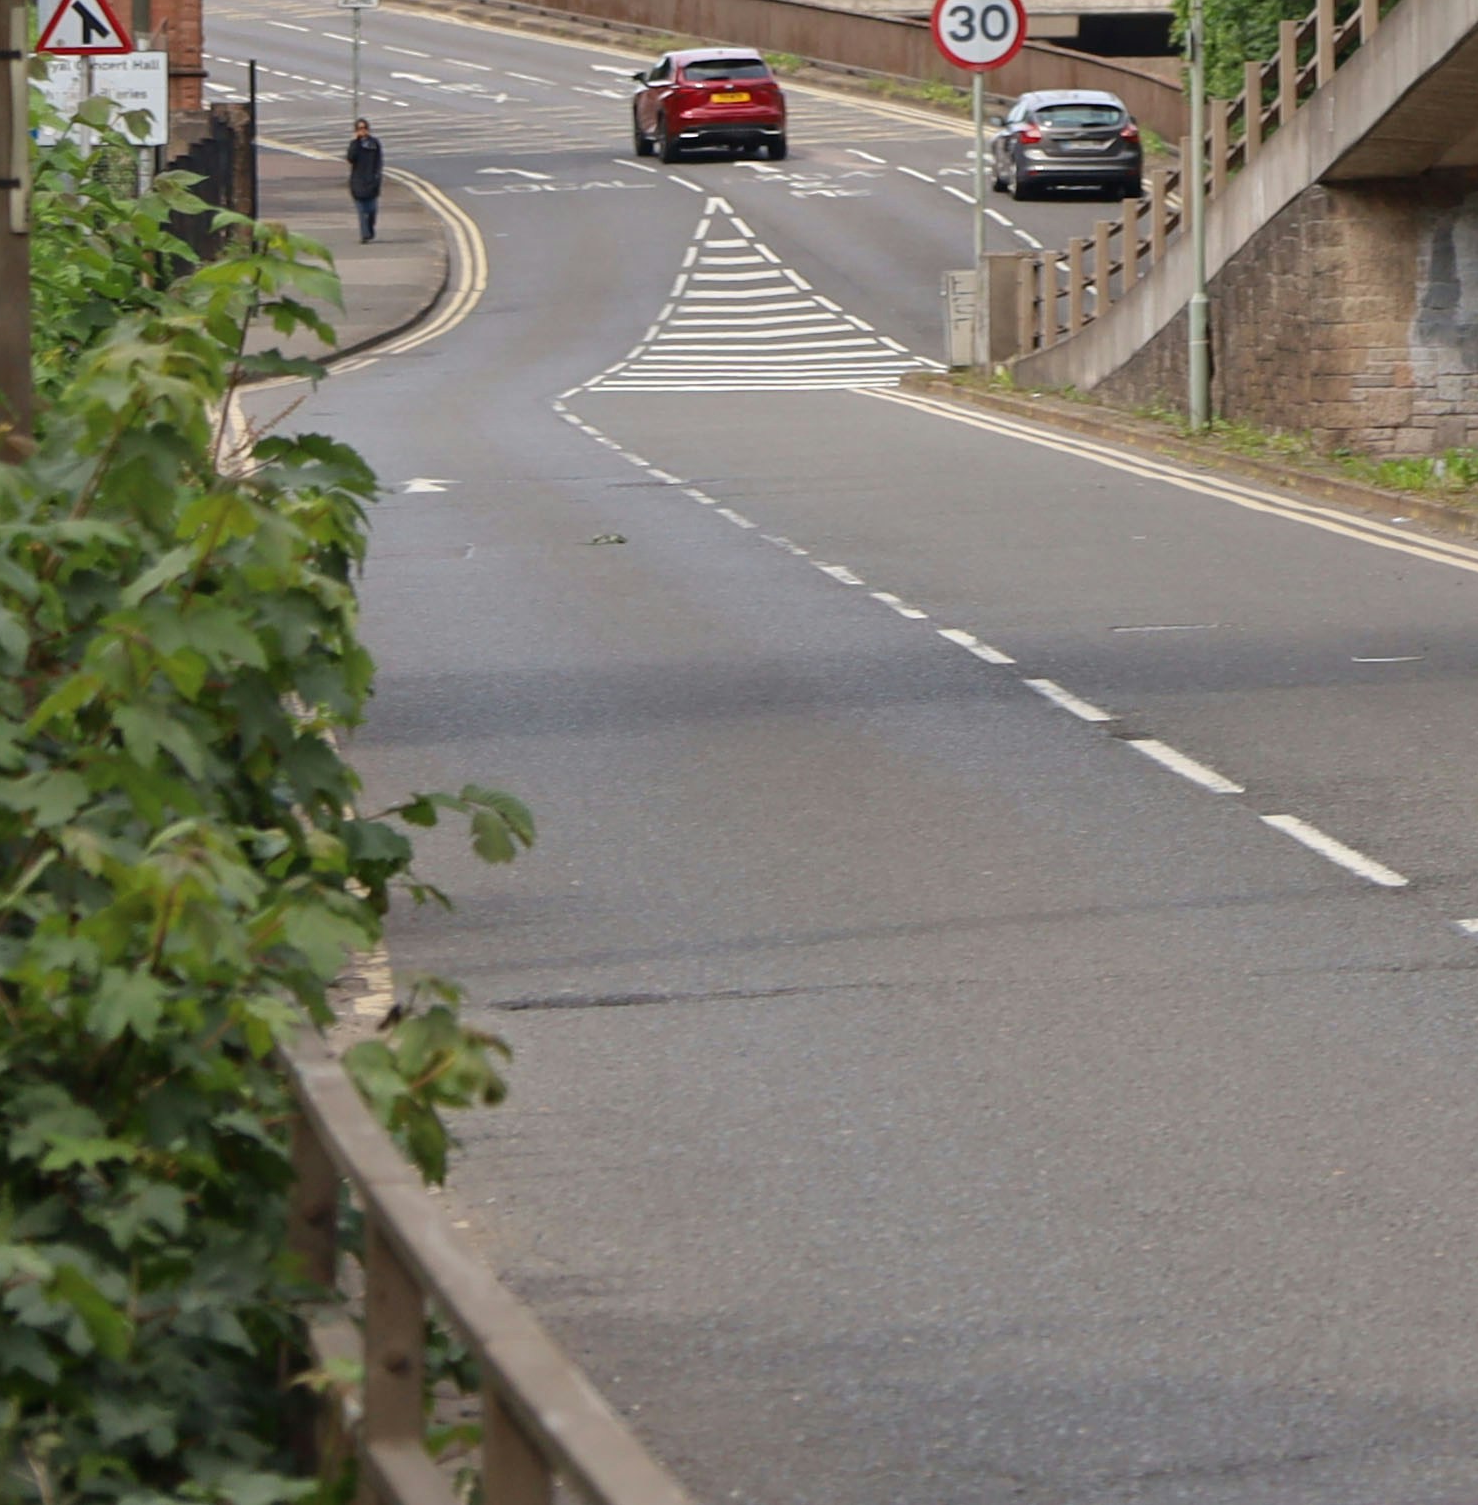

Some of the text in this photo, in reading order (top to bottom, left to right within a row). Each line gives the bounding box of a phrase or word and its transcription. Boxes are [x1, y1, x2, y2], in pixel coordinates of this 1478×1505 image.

[948, 4, 1010, 42] 30
[74, 60, 128, 71] Cncert
[132, 59, 160, 71] Hall
